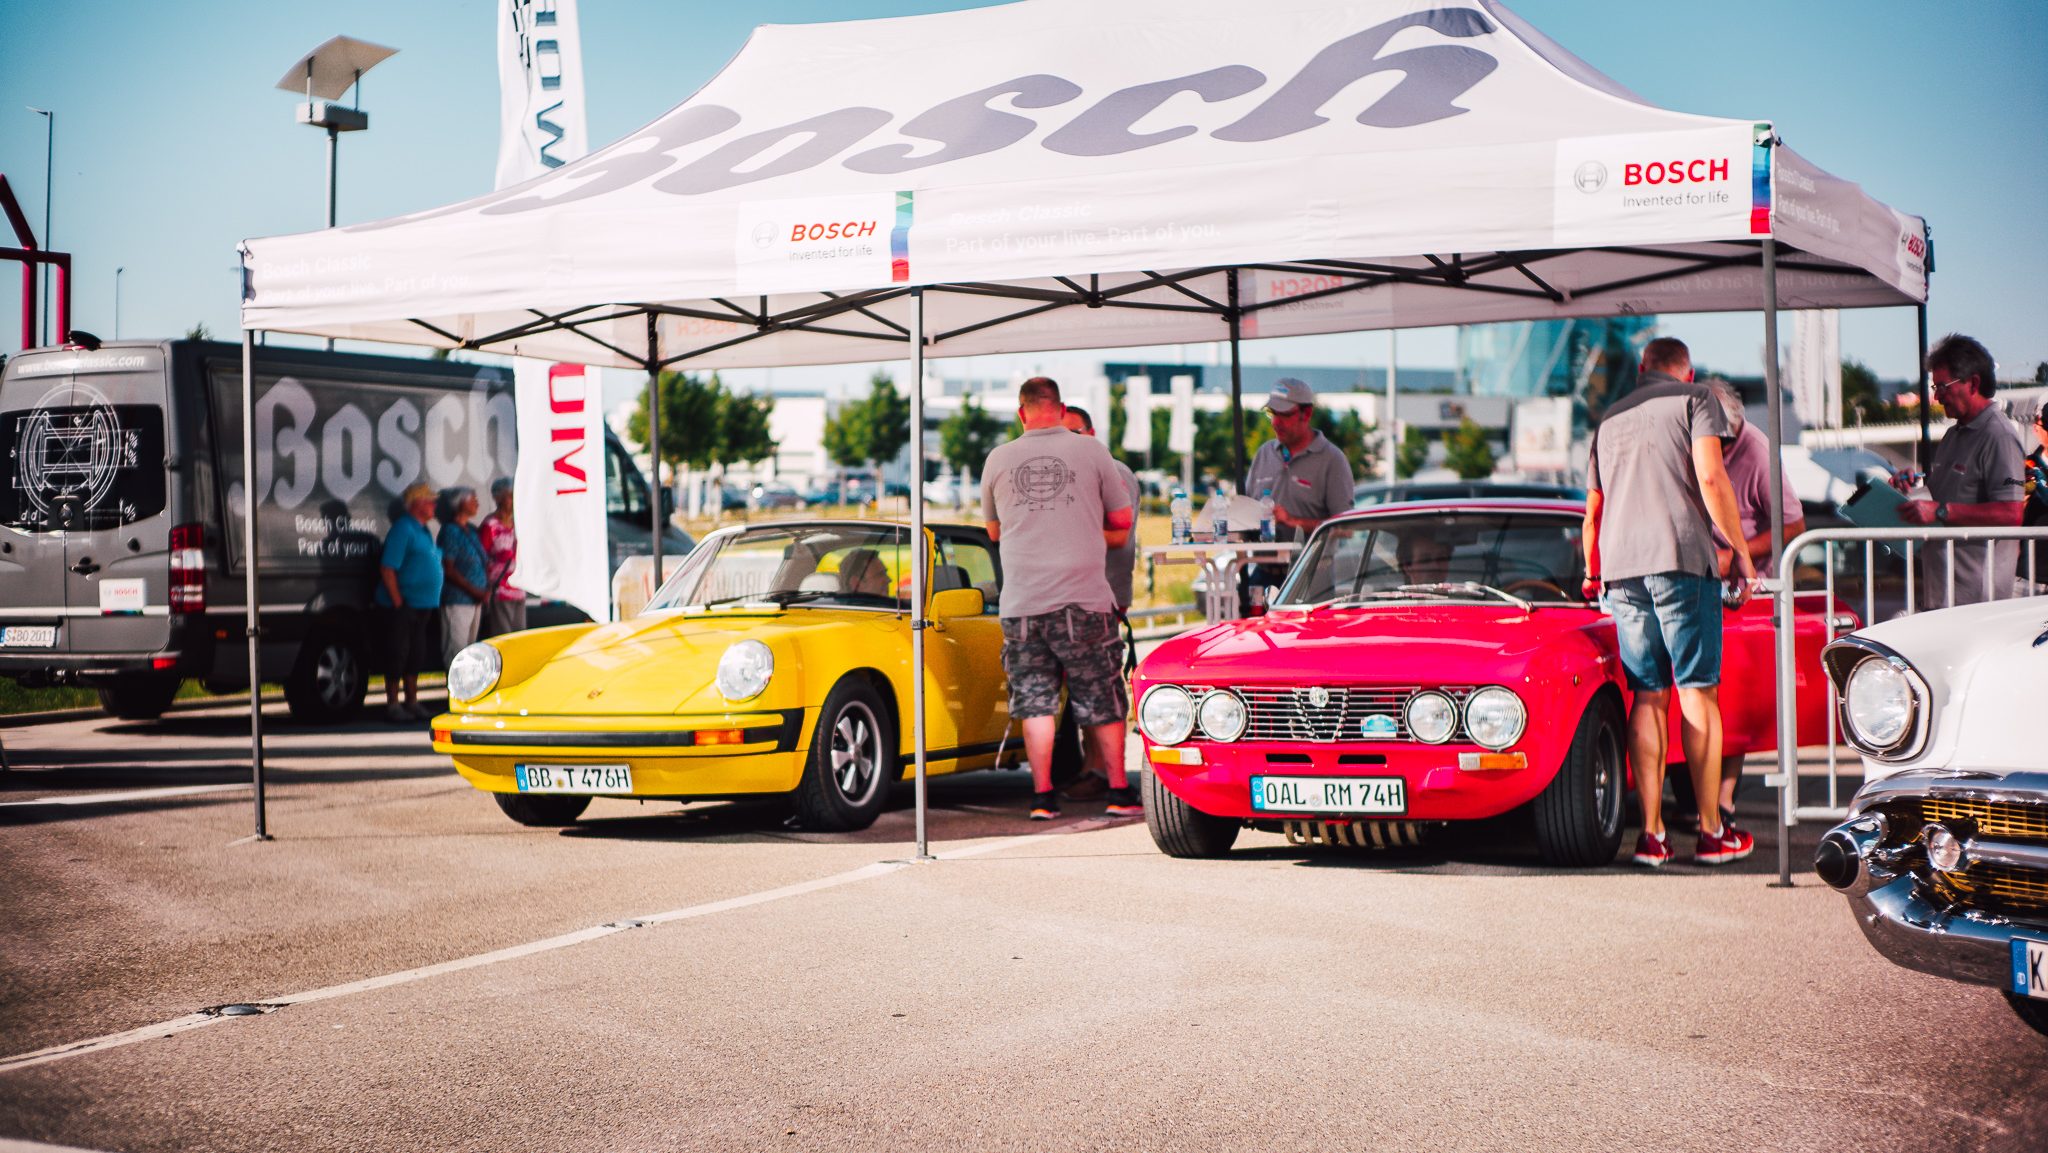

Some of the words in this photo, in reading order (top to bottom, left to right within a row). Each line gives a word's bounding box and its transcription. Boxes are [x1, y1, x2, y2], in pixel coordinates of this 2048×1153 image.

[1624, 158, 1729, 186] BOSCH
[1622, 193, 1683, 208] Invented
[1686, 192, 1704, 205] for
[1707, 191, 1730, 204] life
[1017, 202, 1093, 222] Classic
[790, 220, 877, 242] BOSCH
[945, 236, 985, 255] Part
[991, 233, 1010, 252] of
[1016, 232, 1058, 254] your
[1107, 227, 1149, 245] Part
[1154, 222, 1174, 241] of
[1180, 224, 1222, 243] you.
[788, 247, 836, 263] Invented
[838, 245, 855, 258] for
[855, 244, 873, 257] life
[228, 366, 518, 517] Bosch
[297, 536, 325, 557] Part
[327, 536, 340, 556] of
[527, 767, 552, 789] BB
[563, 767, 575, 788] T
[581, 767, 629, 789] 476H
[1266, 782, 1307, 806] OAL
[1324, 783, 1352, 806] RM
[1359, 784, 1401, 807] 74H
[2030, 949, 2046, 992] K
